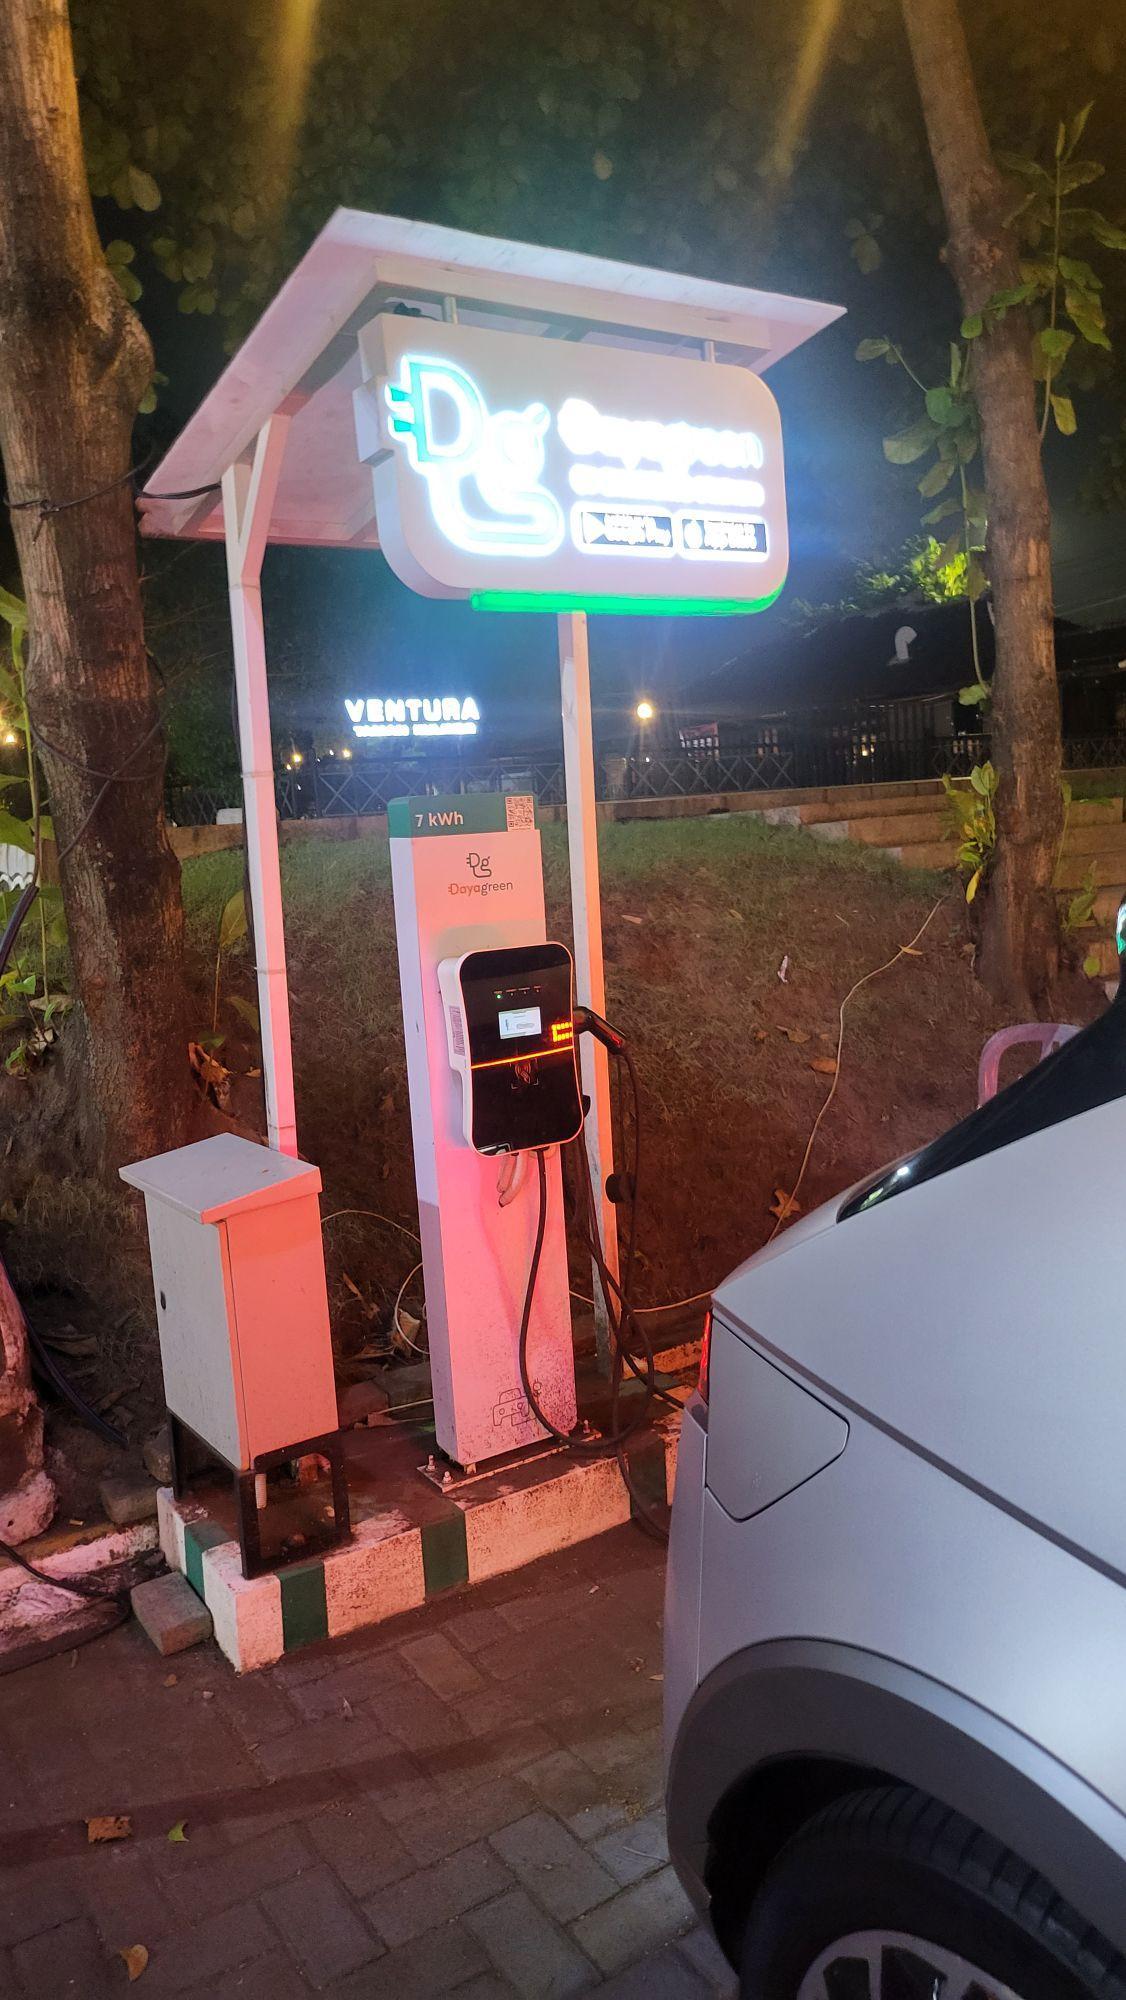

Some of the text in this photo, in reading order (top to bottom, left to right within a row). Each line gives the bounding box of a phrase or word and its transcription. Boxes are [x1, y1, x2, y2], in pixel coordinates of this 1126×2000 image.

[344, 697, 480, 722] VENTURA
[415, 811, 464, 827] 7 kWh
[448, 881, 513, 896] Dayagreen
